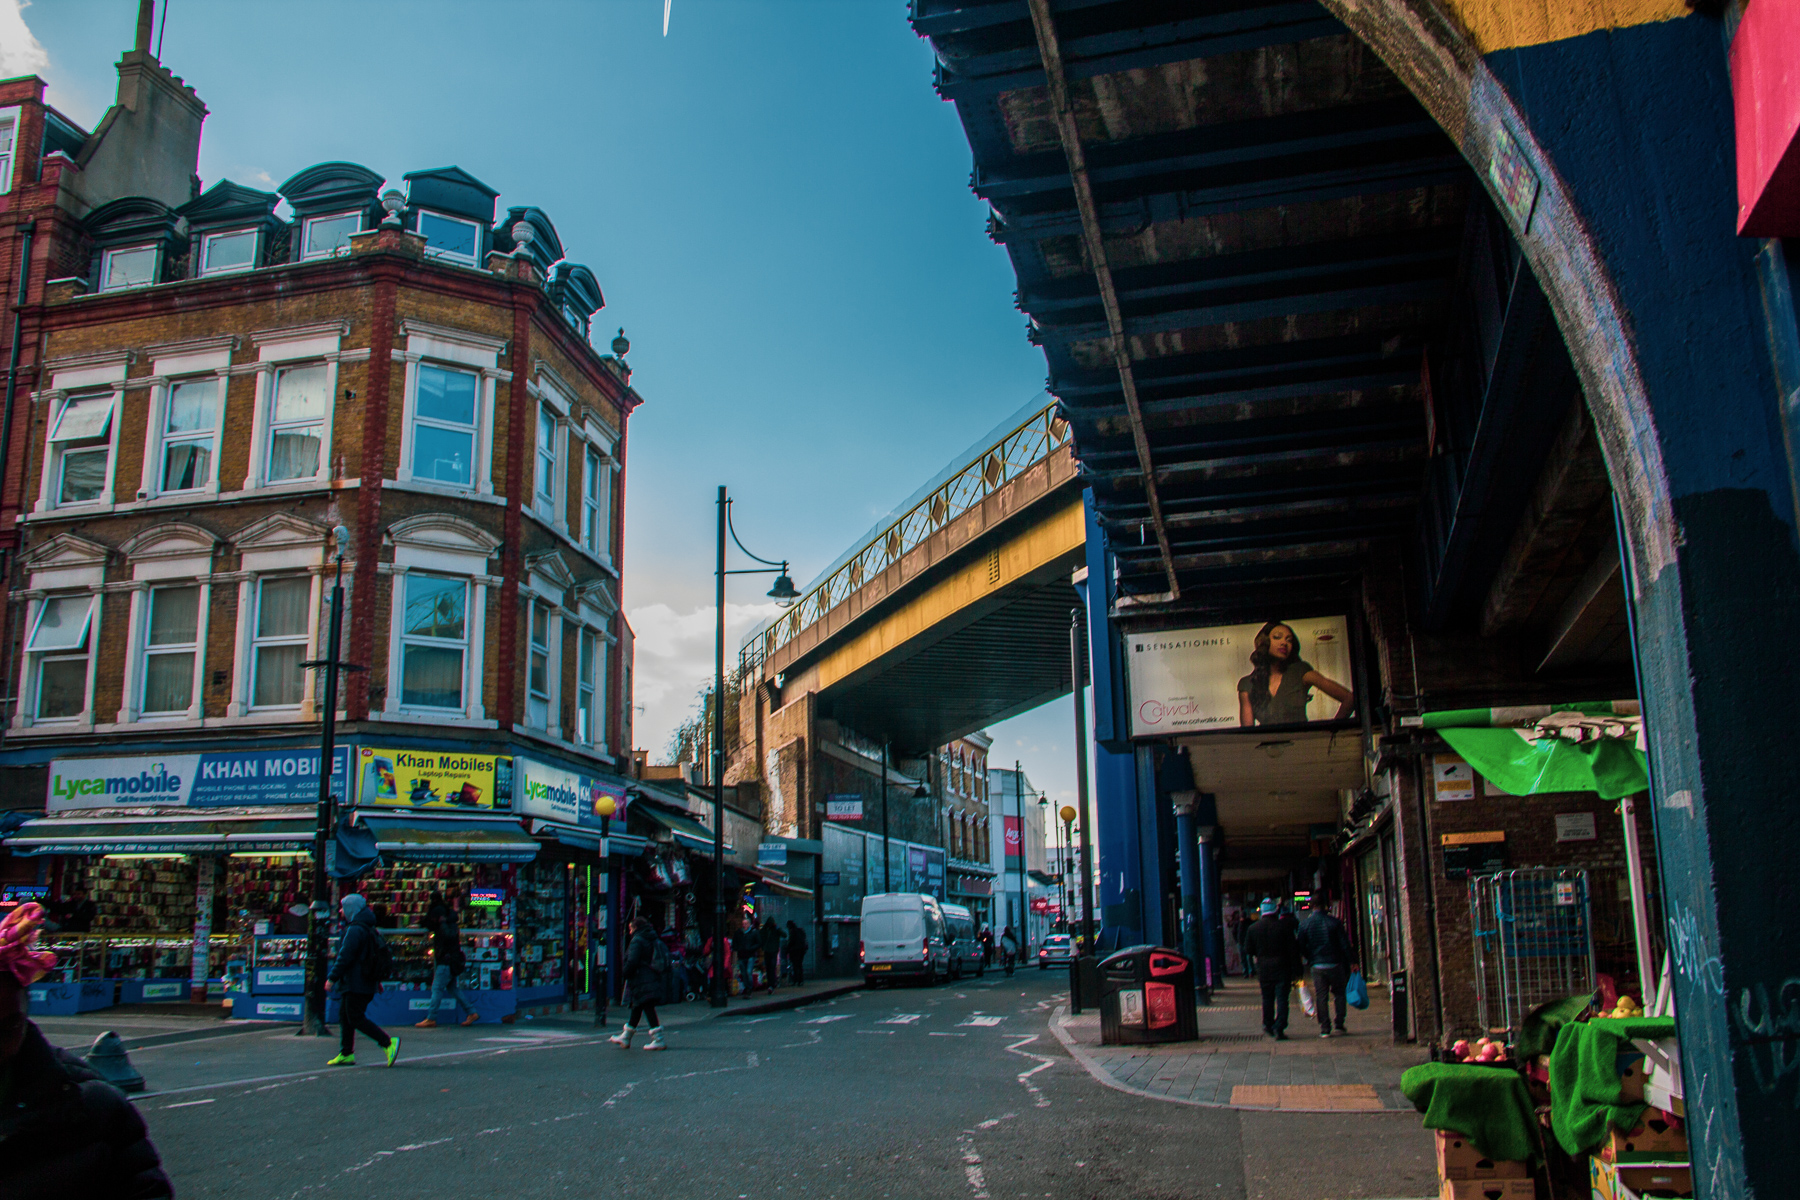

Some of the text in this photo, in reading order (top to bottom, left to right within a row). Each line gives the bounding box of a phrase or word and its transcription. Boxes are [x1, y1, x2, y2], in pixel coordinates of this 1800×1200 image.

[1147, 638, 1231, 651] SENSATIONNEL
[1139, 699, 1199, 725] Catwalk
[202, 760, 258, 779] KHAN
[396, 753, 494, 772] Khan Mobiles
[418, 770, 471, 779] Laptop Repairs
[53, 770, 181, 800] Lycamobile
[524, 774, 577, 806] Lycamobile
